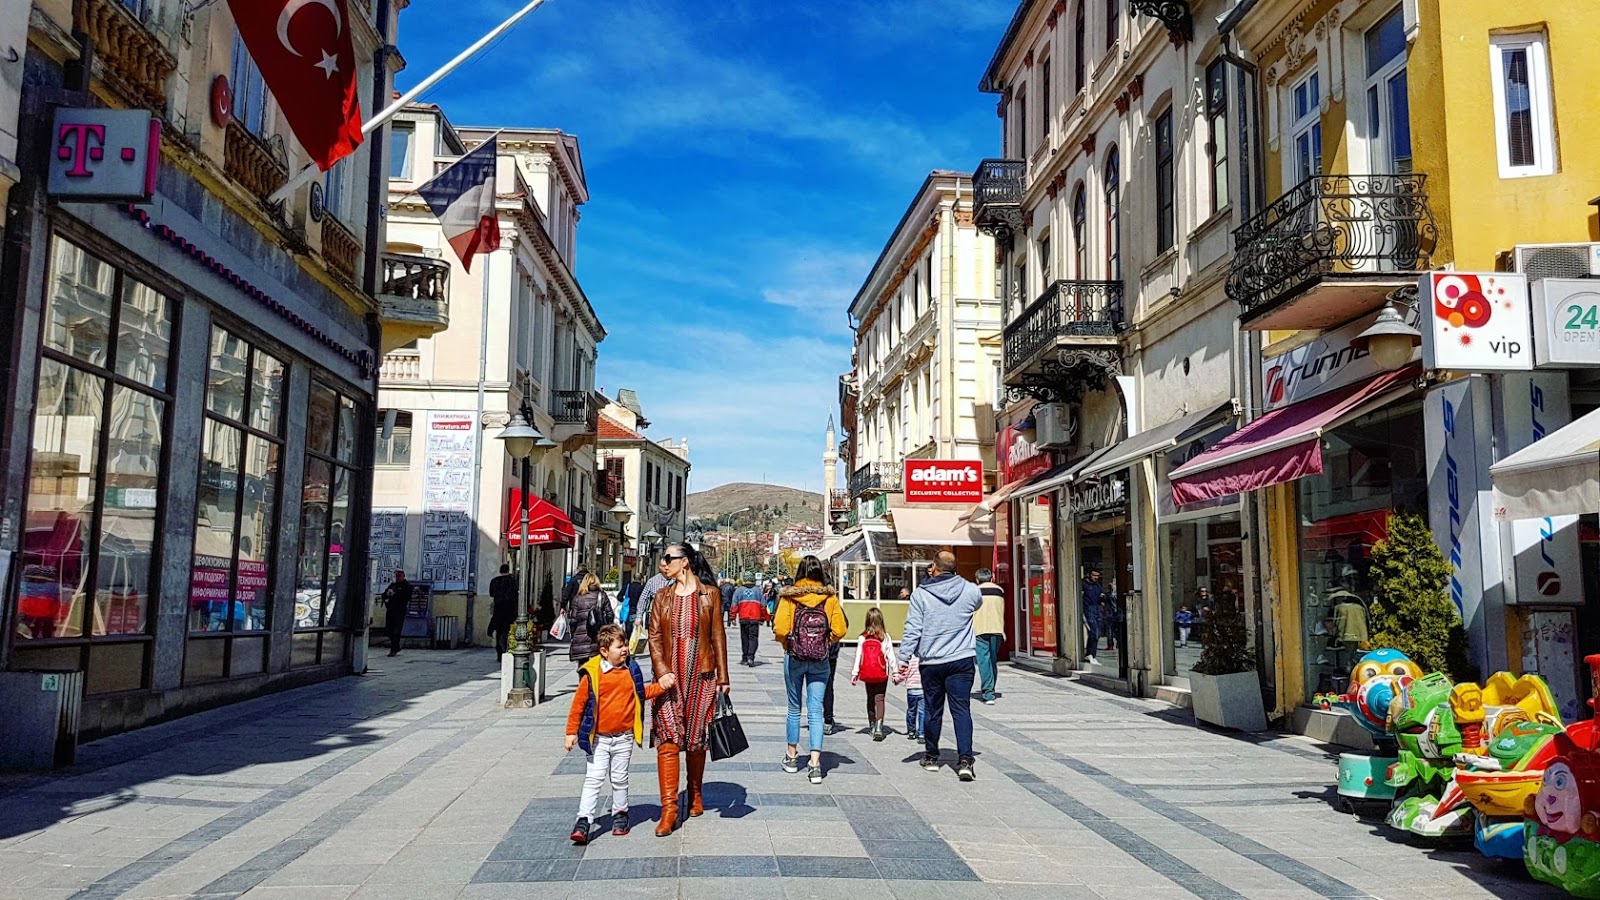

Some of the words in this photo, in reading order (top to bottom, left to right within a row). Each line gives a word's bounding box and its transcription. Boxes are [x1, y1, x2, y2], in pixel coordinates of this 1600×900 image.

[1564, 304, 1599, 330] 24
[1564, 331, 1595, 342] OPEN
[1489, 335, 1521, 359] vip
[911, 465, 978, 482] adam's
